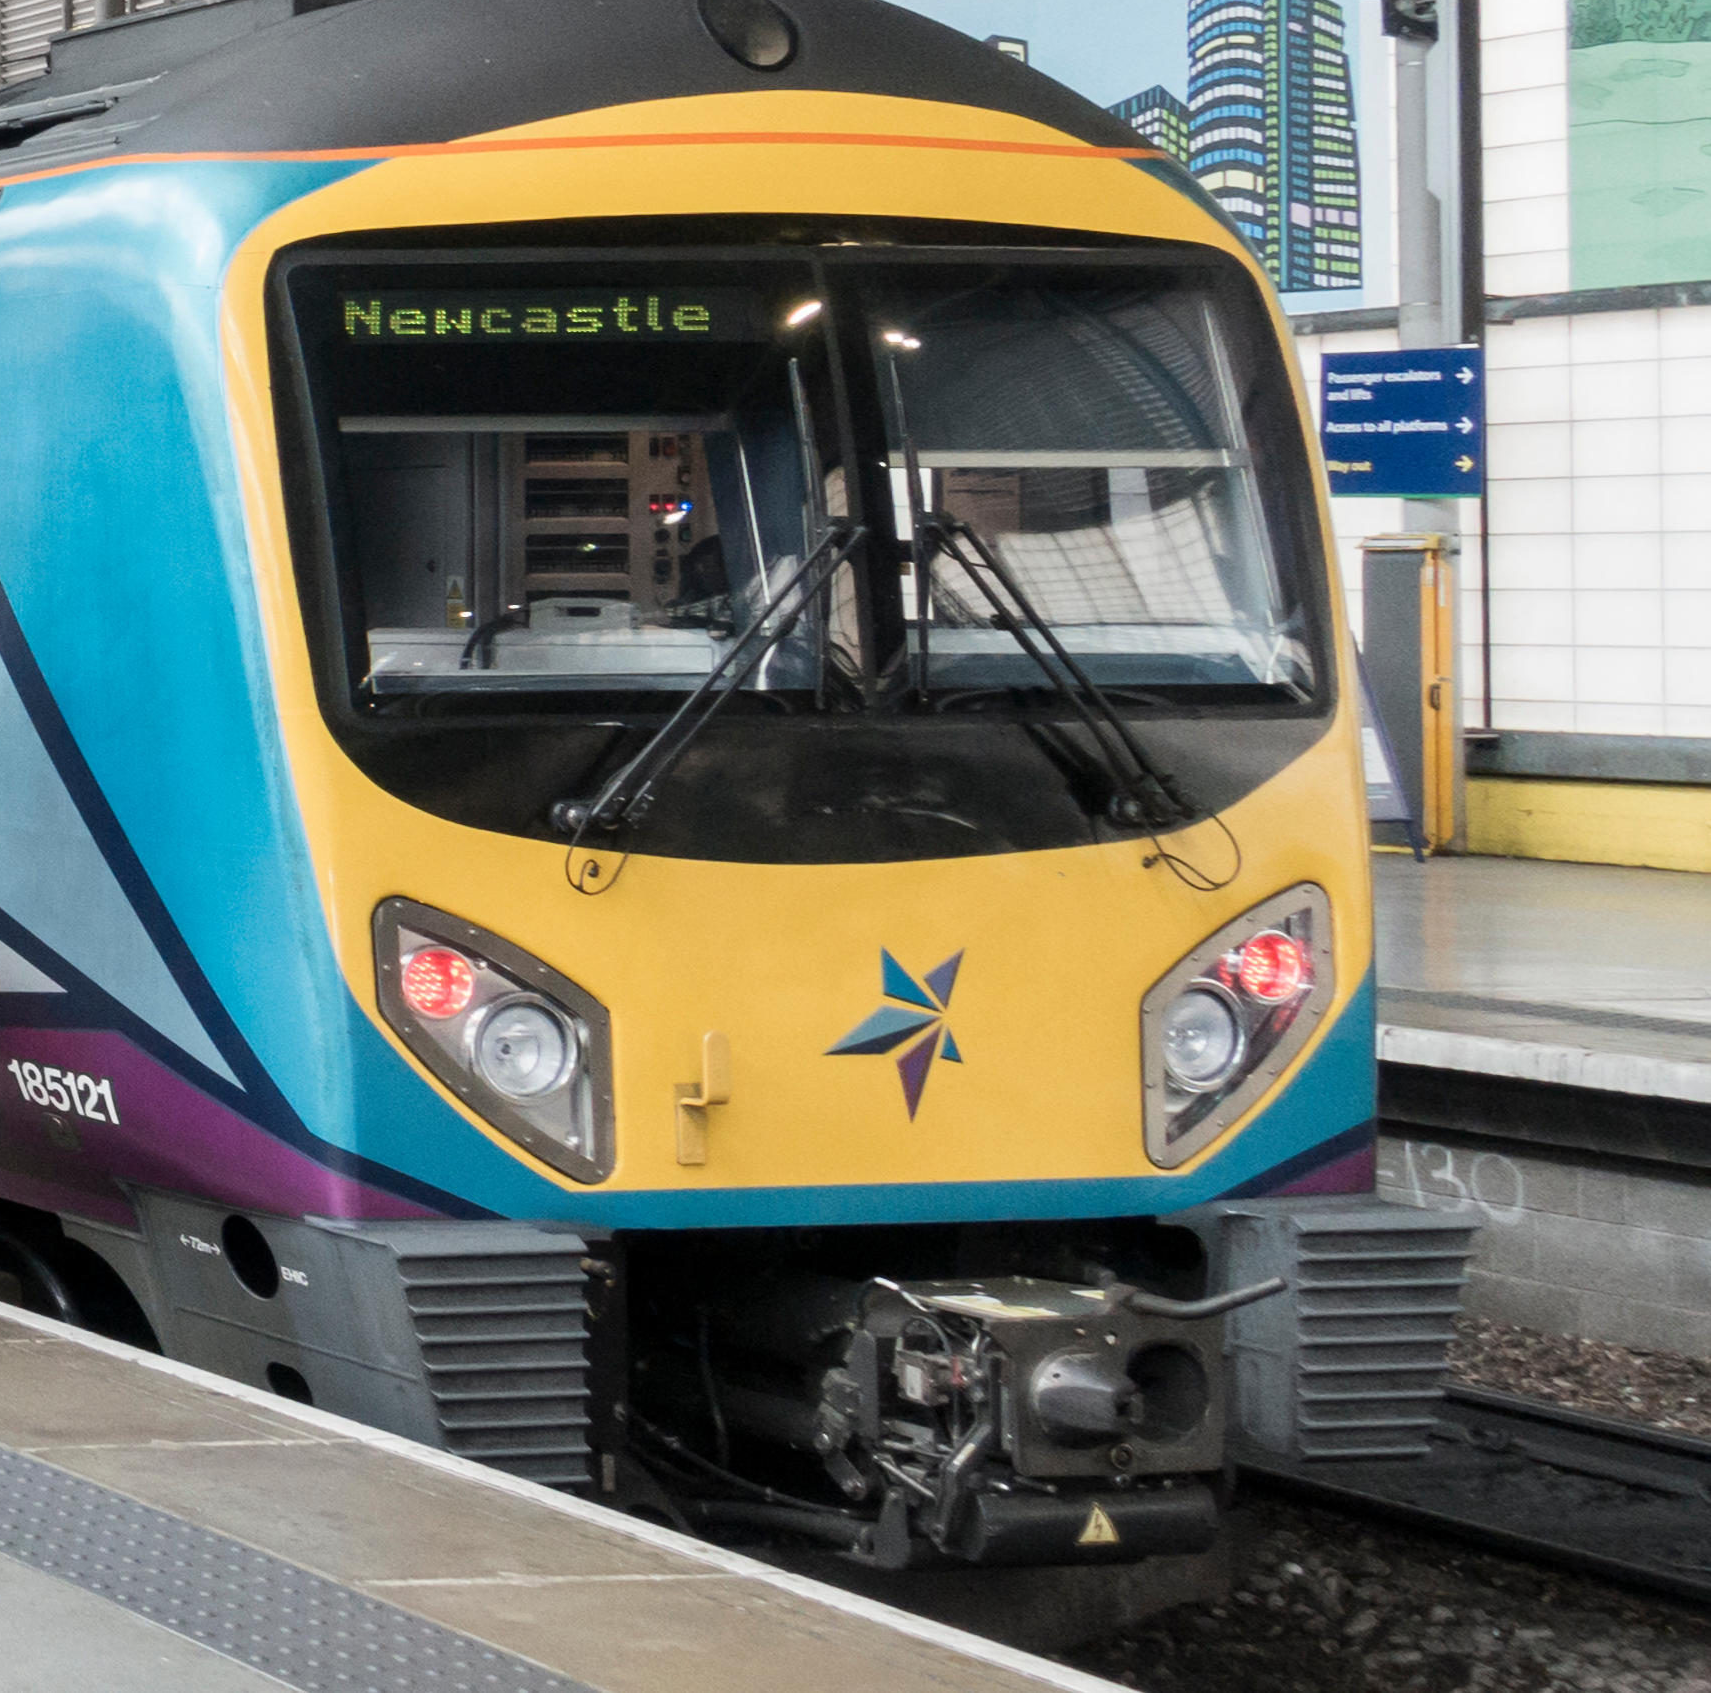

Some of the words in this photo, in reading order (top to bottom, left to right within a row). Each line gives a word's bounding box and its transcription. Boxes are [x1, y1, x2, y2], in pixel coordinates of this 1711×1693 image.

[344, 296, 710, 336] Newcastle
[1328, 372, 1383, 385] Passenger
[1384, 370, 1442, 382] escalators
[1327, 389, 1349, 401] and
[1350, 388, 1373, 400] lifts
[1325, 422, 1362, 433] Access
[1363, 422, 1376, 432] to
[1392, 420, 1448, 434] platforms
[1351, 461, 1372, 472] out
[7, 1059, 120, 1125] 185121
